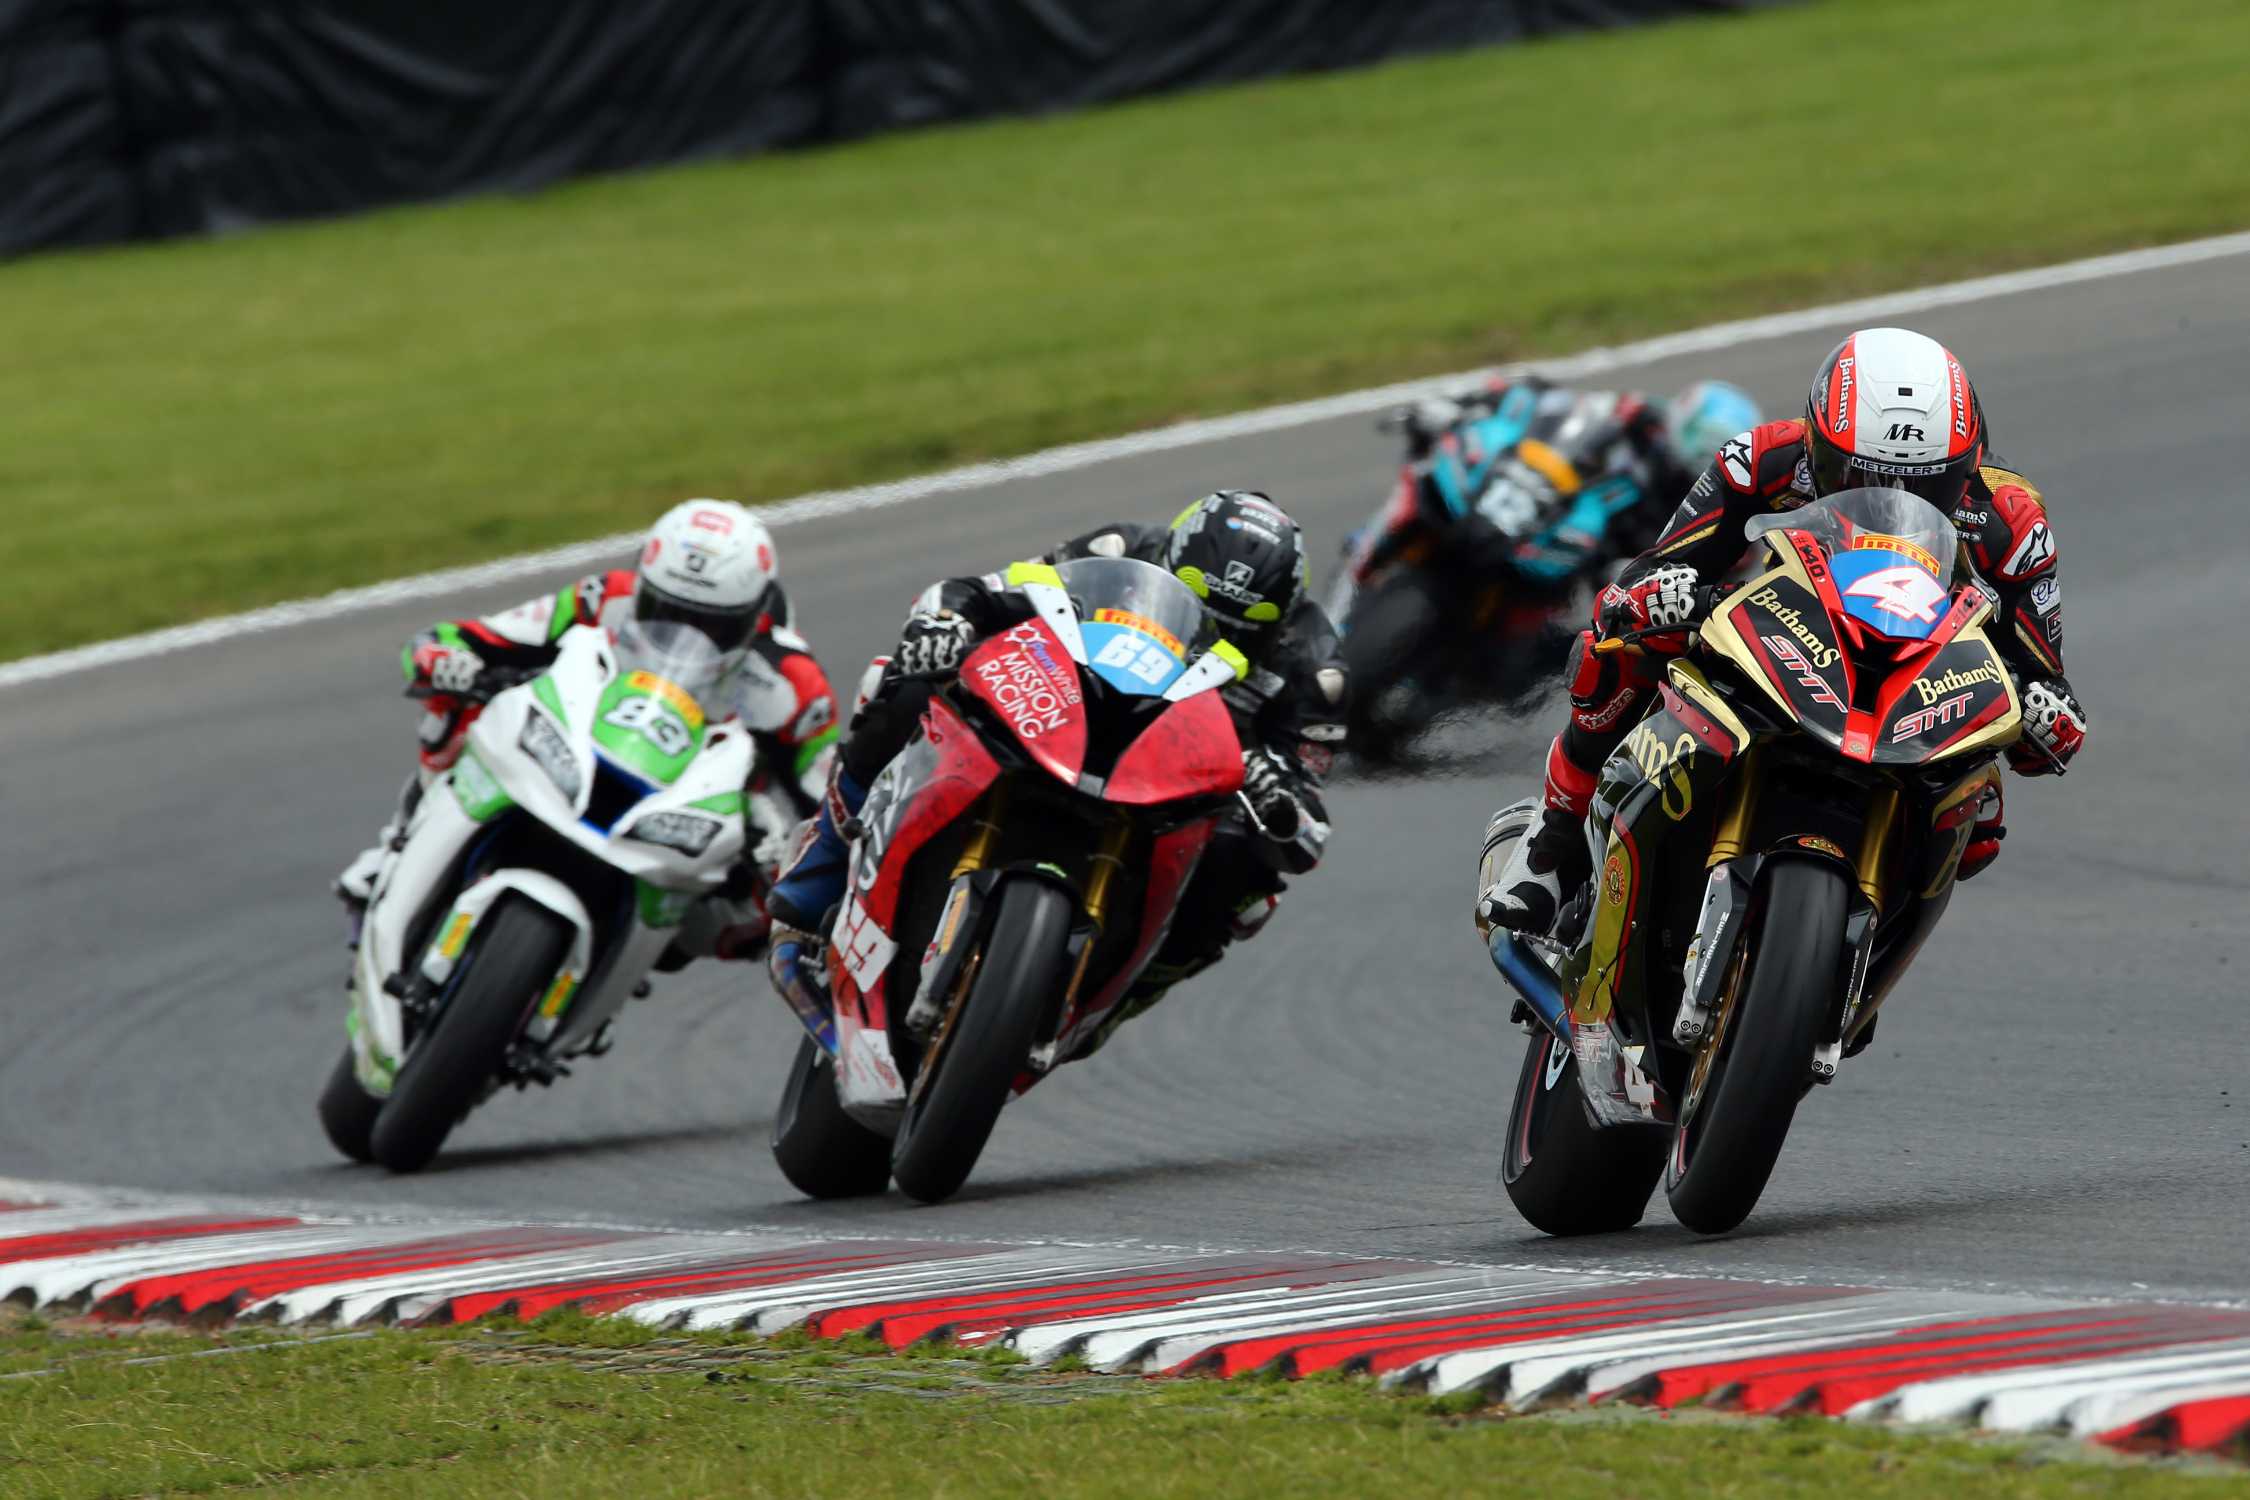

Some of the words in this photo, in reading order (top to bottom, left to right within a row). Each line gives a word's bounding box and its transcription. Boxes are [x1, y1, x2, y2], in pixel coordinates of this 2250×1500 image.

[1852, 457, 1932, 475] METZELER
[1854, 535, 1940, 577] PIRELLI
[1843, 566, 1947, 624] 4
[1093, 633, 1174, 686] 69
[1760, 635, 1848, 713] SMT
[976, 660, 1044, 738] RACING
[998, 651, 1069, 730] MISSION
[1892, 692, 1973, 744] SMT
